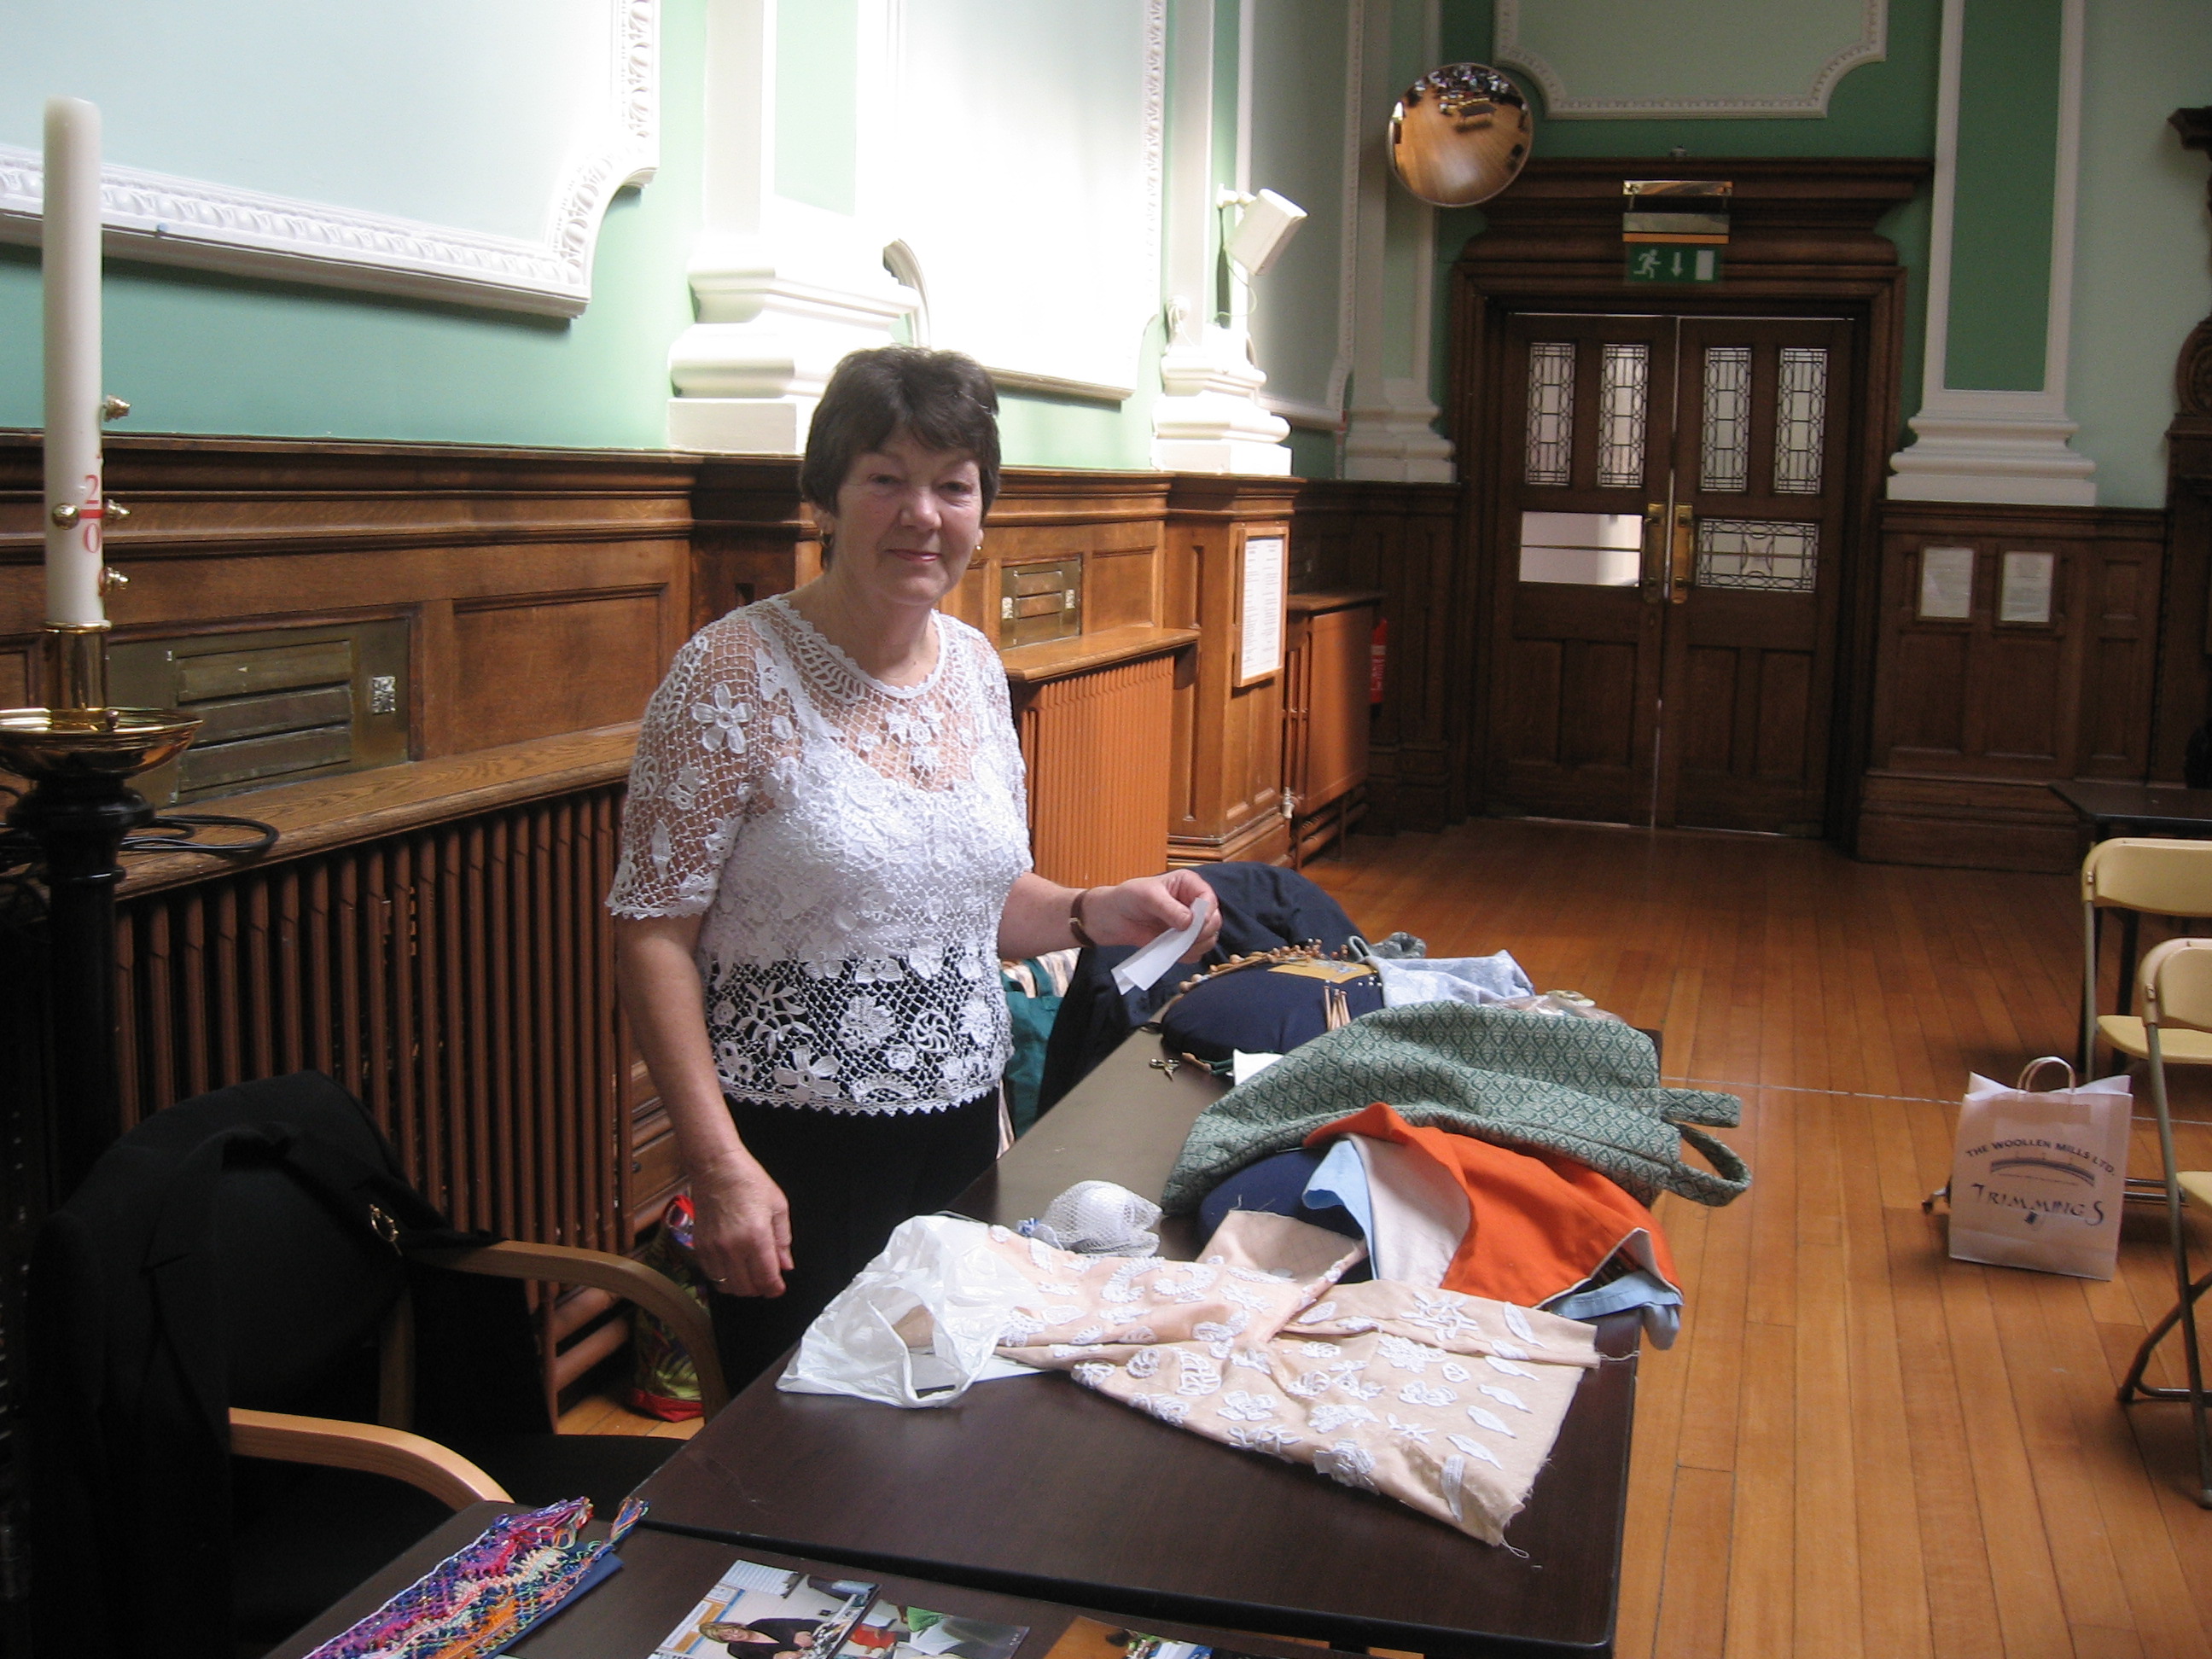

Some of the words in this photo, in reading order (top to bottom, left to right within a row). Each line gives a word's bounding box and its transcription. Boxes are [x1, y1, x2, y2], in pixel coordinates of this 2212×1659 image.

[84, 474, 99, 504] 2
[1965, 1144, 1989, 1156] THE
[1991, 1139, 2051, 1150] WOOLLEN
[2055, 1143, 2090, 1159] MILLS
